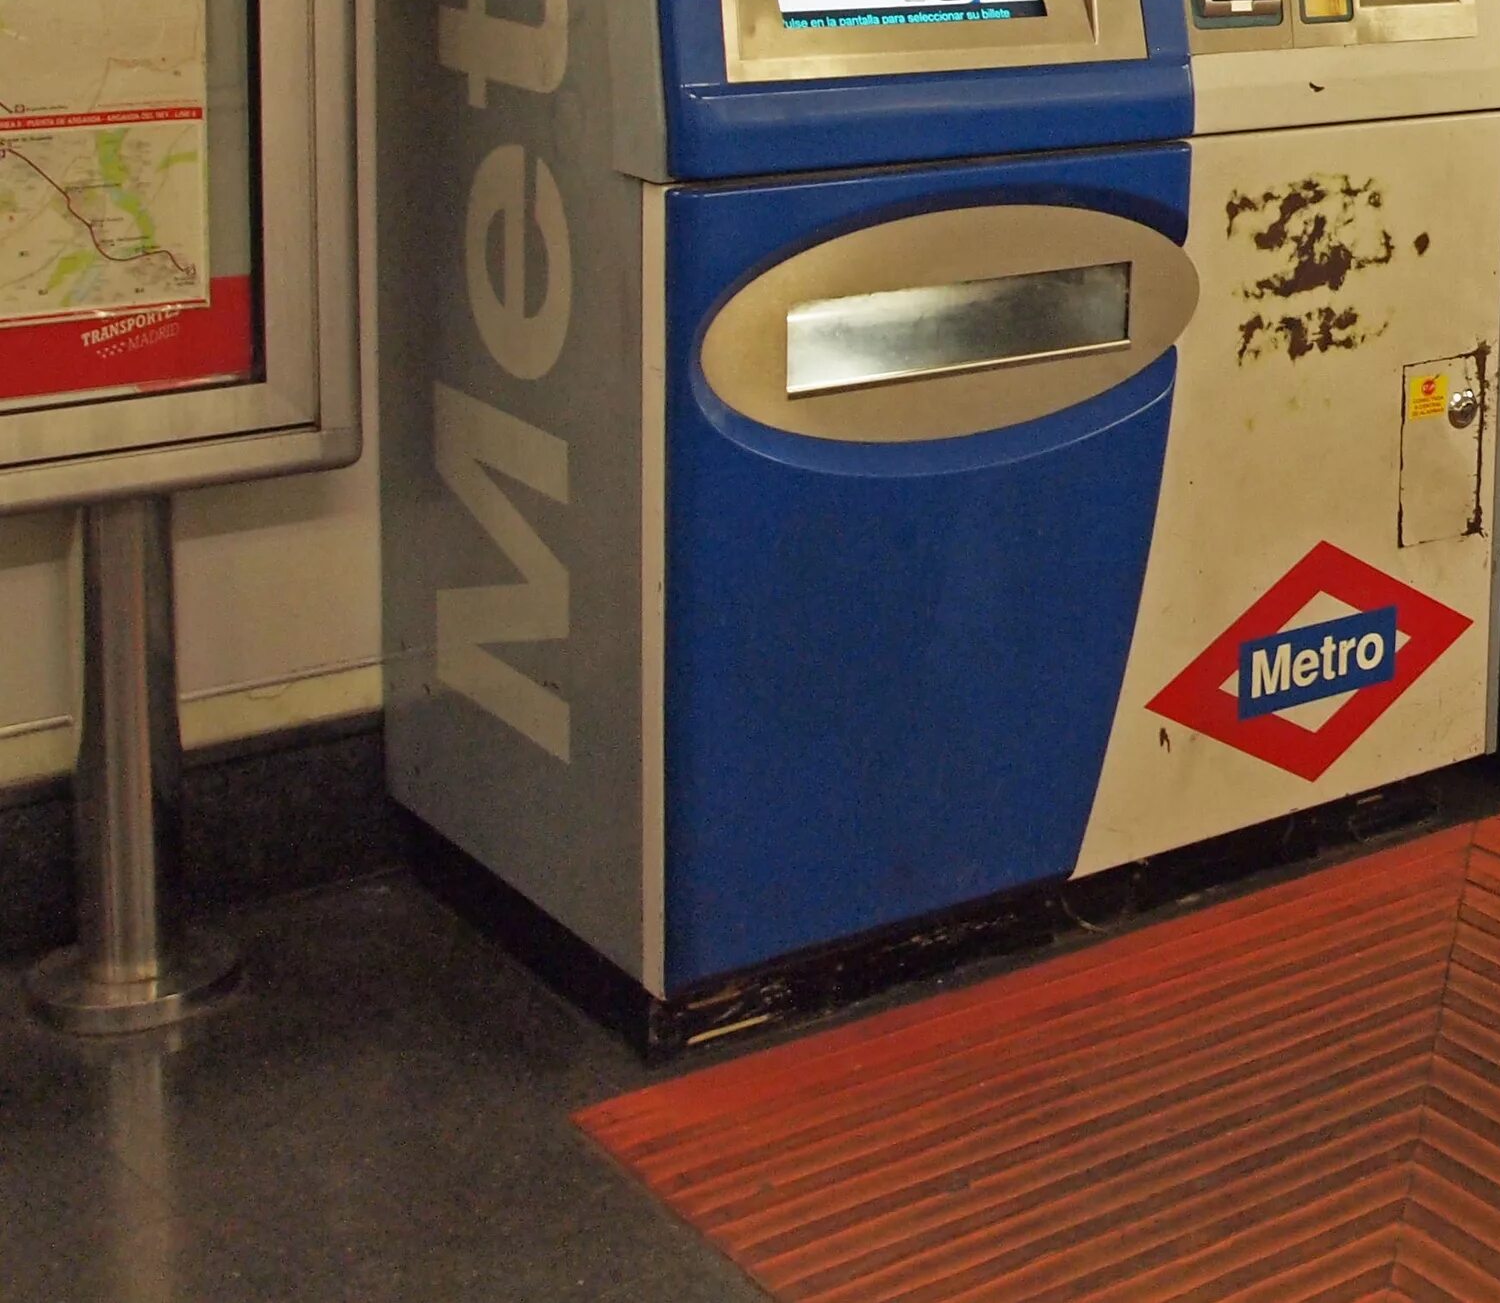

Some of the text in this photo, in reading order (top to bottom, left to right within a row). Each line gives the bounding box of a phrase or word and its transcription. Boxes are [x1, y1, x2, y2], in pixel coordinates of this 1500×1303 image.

[810, 19, 825, 28] en
[826, 16, 837, 27] la
[839, 13, 880, 27] pantalla
[882, 14, 905, 26] para
[907, 10, 964, 24] seleccionar
[967, 11, 980, 21] su
[981, 8, 1012, 20] billete
[127, 322, 180, 352] MADRID
[1251, 632, 1384, 699] Metro
